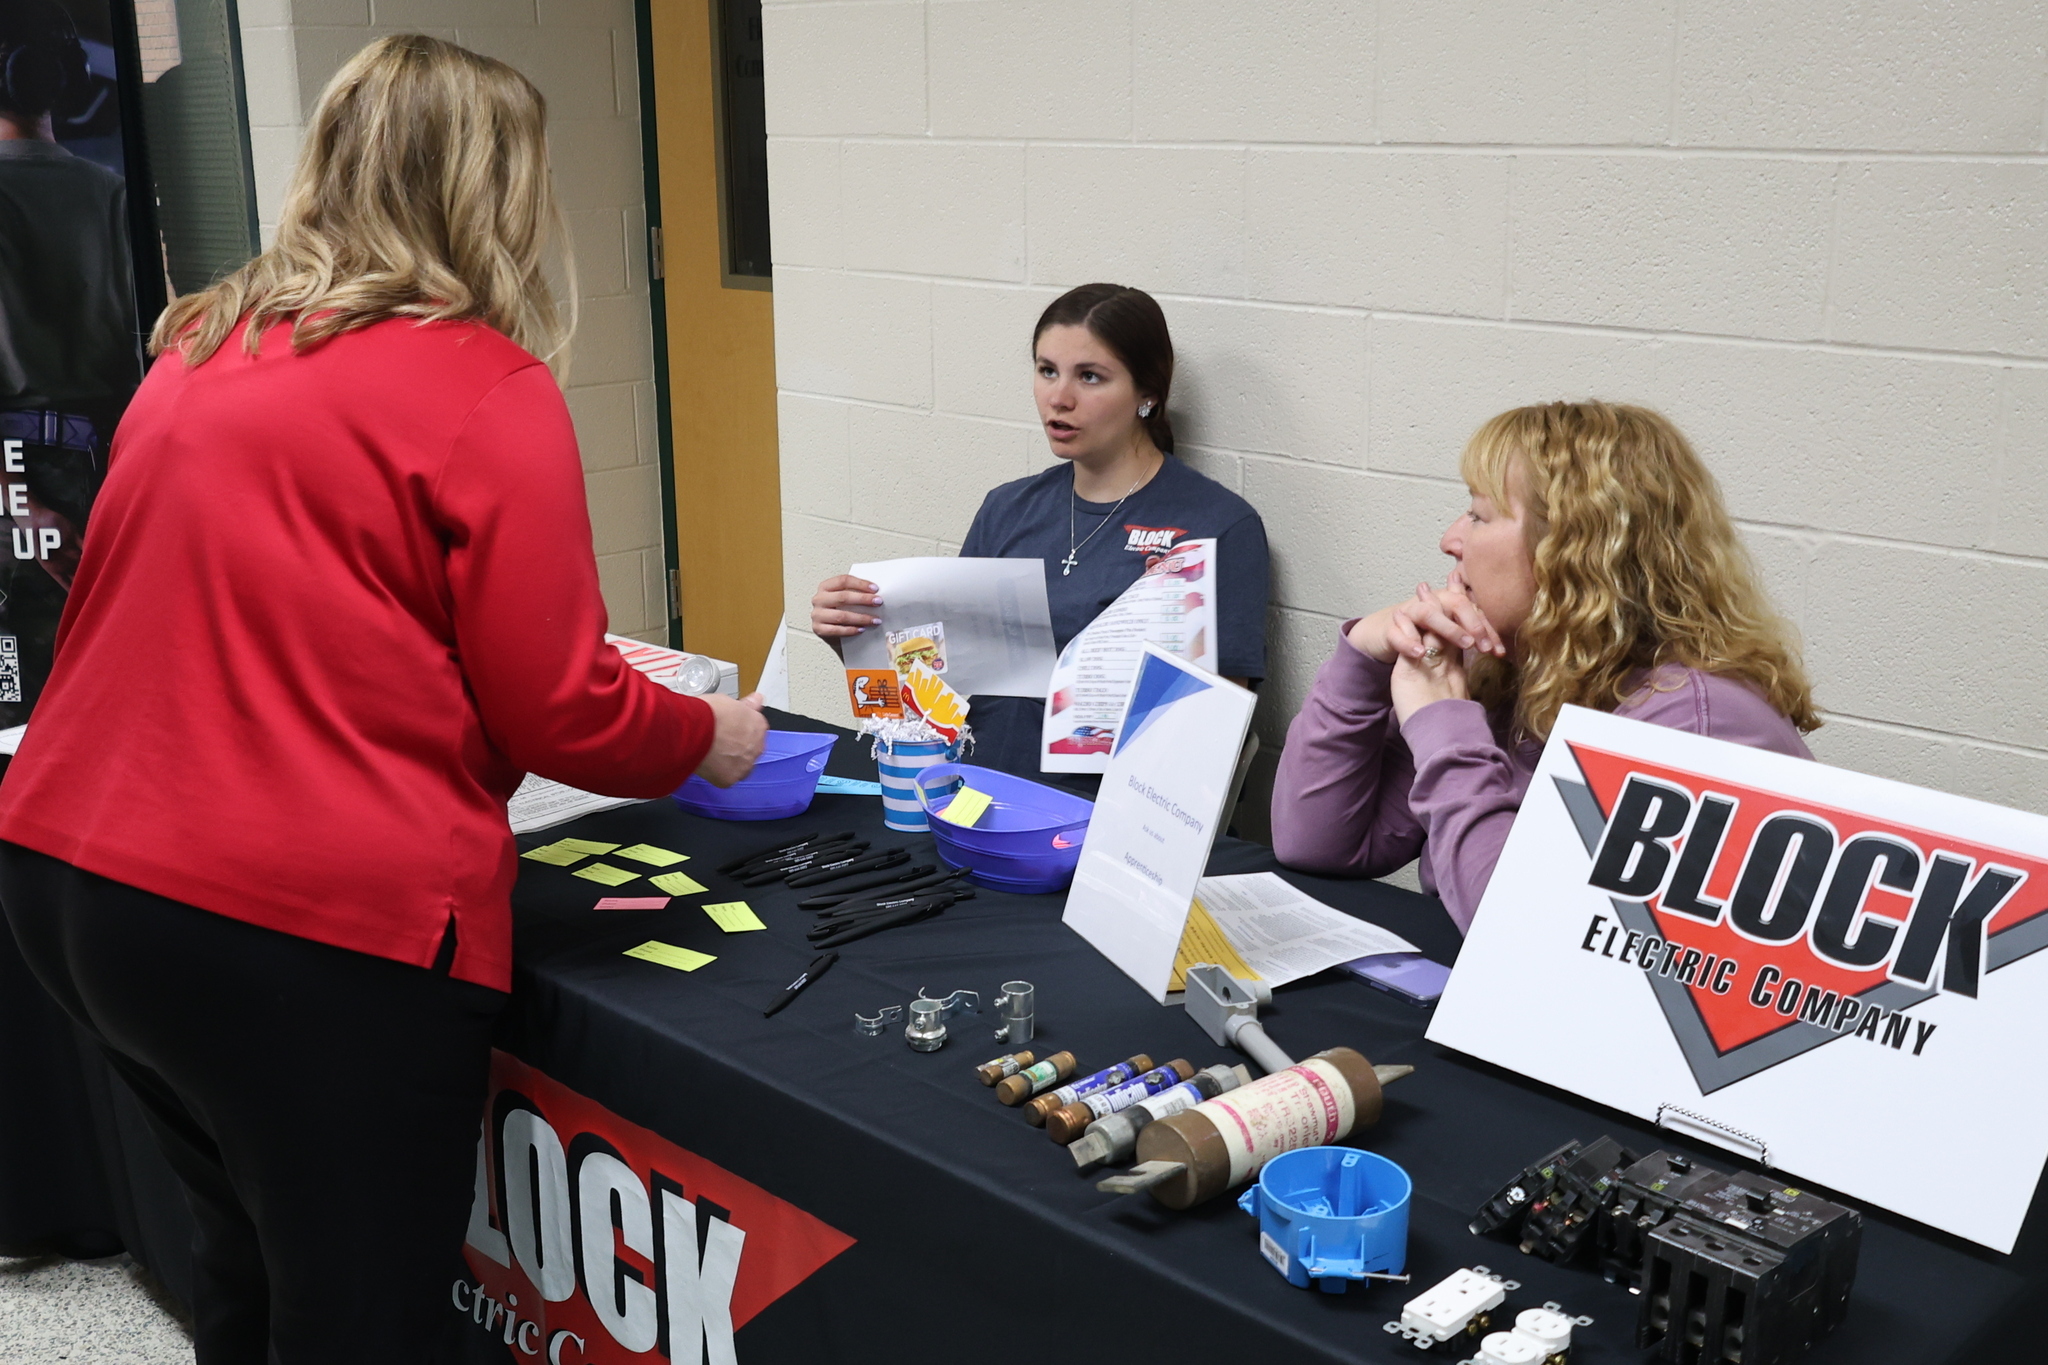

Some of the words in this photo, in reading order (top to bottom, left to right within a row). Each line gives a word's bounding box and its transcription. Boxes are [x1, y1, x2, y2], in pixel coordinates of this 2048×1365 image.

[0, 484, 29, 517] E
[12, 528, 61, 560] UP
[1127, 529, 1176, 548] BLOCK
[889, 630, 911, 645] GIFT
[912, 625, 941, 638] CARD
[1128, 775, 1145, 796] Block
[1145, 786, 1171, 812] Electric
[1171, 803, 1204, 835] Company
[1124, 852, 1163, 886] Apprenticeship
[1586, 774, 2025, 1000] BLOCK
[1581, 913, 1739, 996] ELECTRIC
[1748, 964, 1938, 1057] COMPANY
